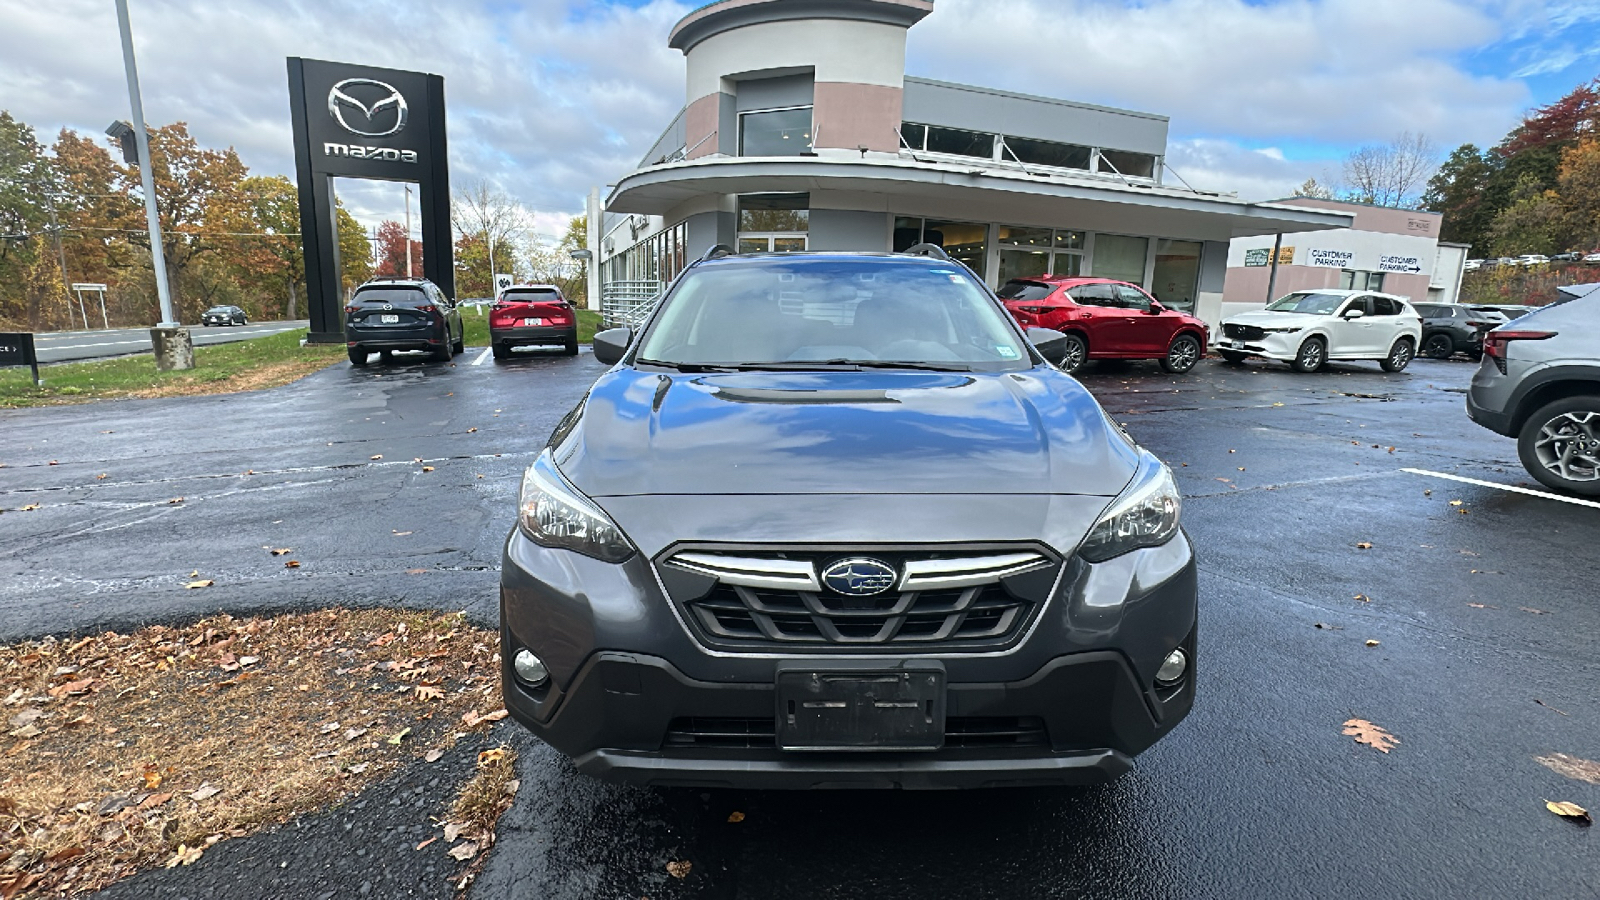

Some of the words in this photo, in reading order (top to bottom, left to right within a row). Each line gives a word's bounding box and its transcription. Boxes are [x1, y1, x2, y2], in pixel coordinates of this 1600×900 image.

[1311, 249, 1353, 260] CUSTOMER
[1314, 258, 1347, 268] PARKING
[1380, 256, 1418, 265] CUSTOMER
[1379, 263, 1408, 272] PARKING
